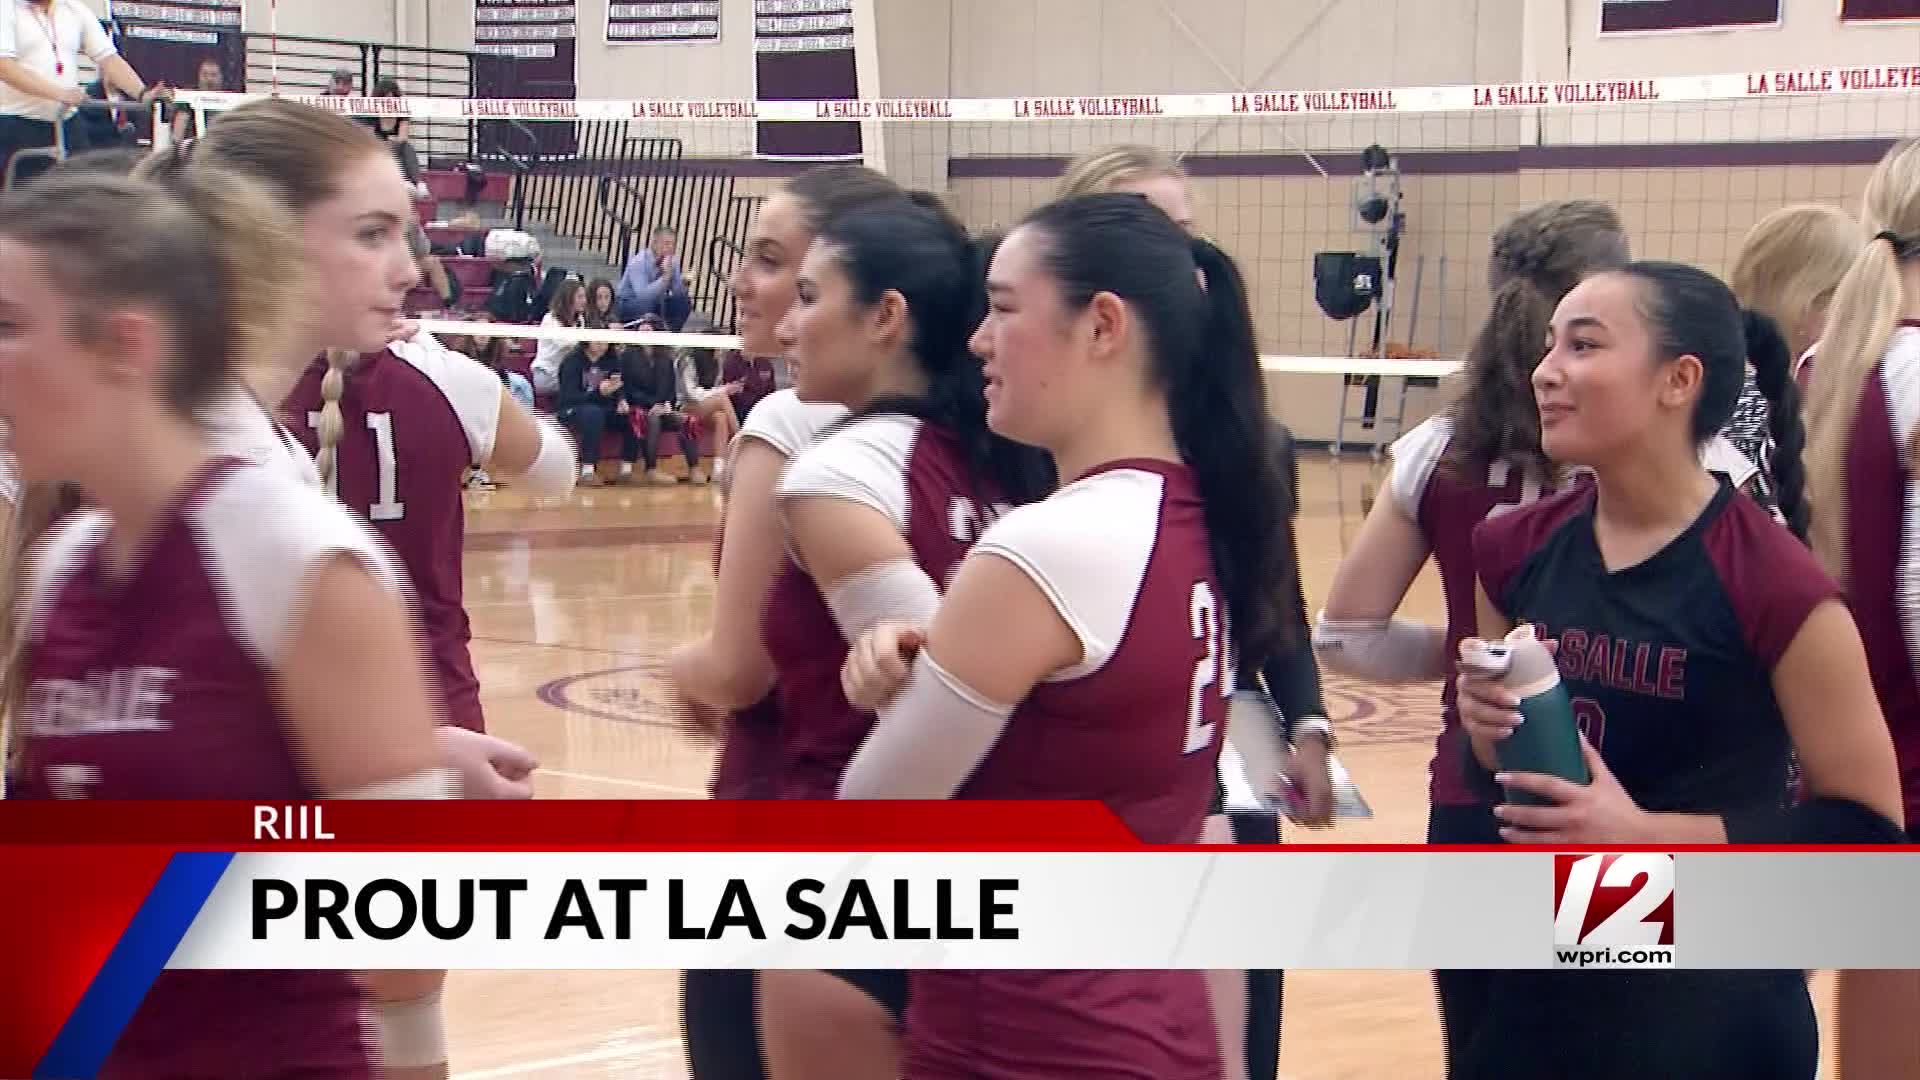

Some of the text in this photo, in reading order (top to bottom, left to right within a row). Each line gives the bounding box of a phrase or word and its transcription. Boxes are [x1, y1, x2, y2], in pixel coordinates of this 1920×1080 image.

[1747, 74, 1769, 94] LA
[1775, 71, 1833, 92] SALLE
[1232, 91, 1397, 112] LA SALLE VOLLEYBALL
[1473, 80, 1660, 106] LA SALLE VOLLEYBALL
[350, 98, 411, 114] VOLLEYBALL
[461, 101, 578, 117] LA SALLE VOLLEYBALL
[632, 102, 758, 118] LA SALLE VOLLEYBALL
[816, 101, 952, 117] LA SALLE VOLLEYBALL
[1014, 97, 1164, 117] LA SALLE VOLLEYBALL
[1557, 628, 1688, 700] SALLE
